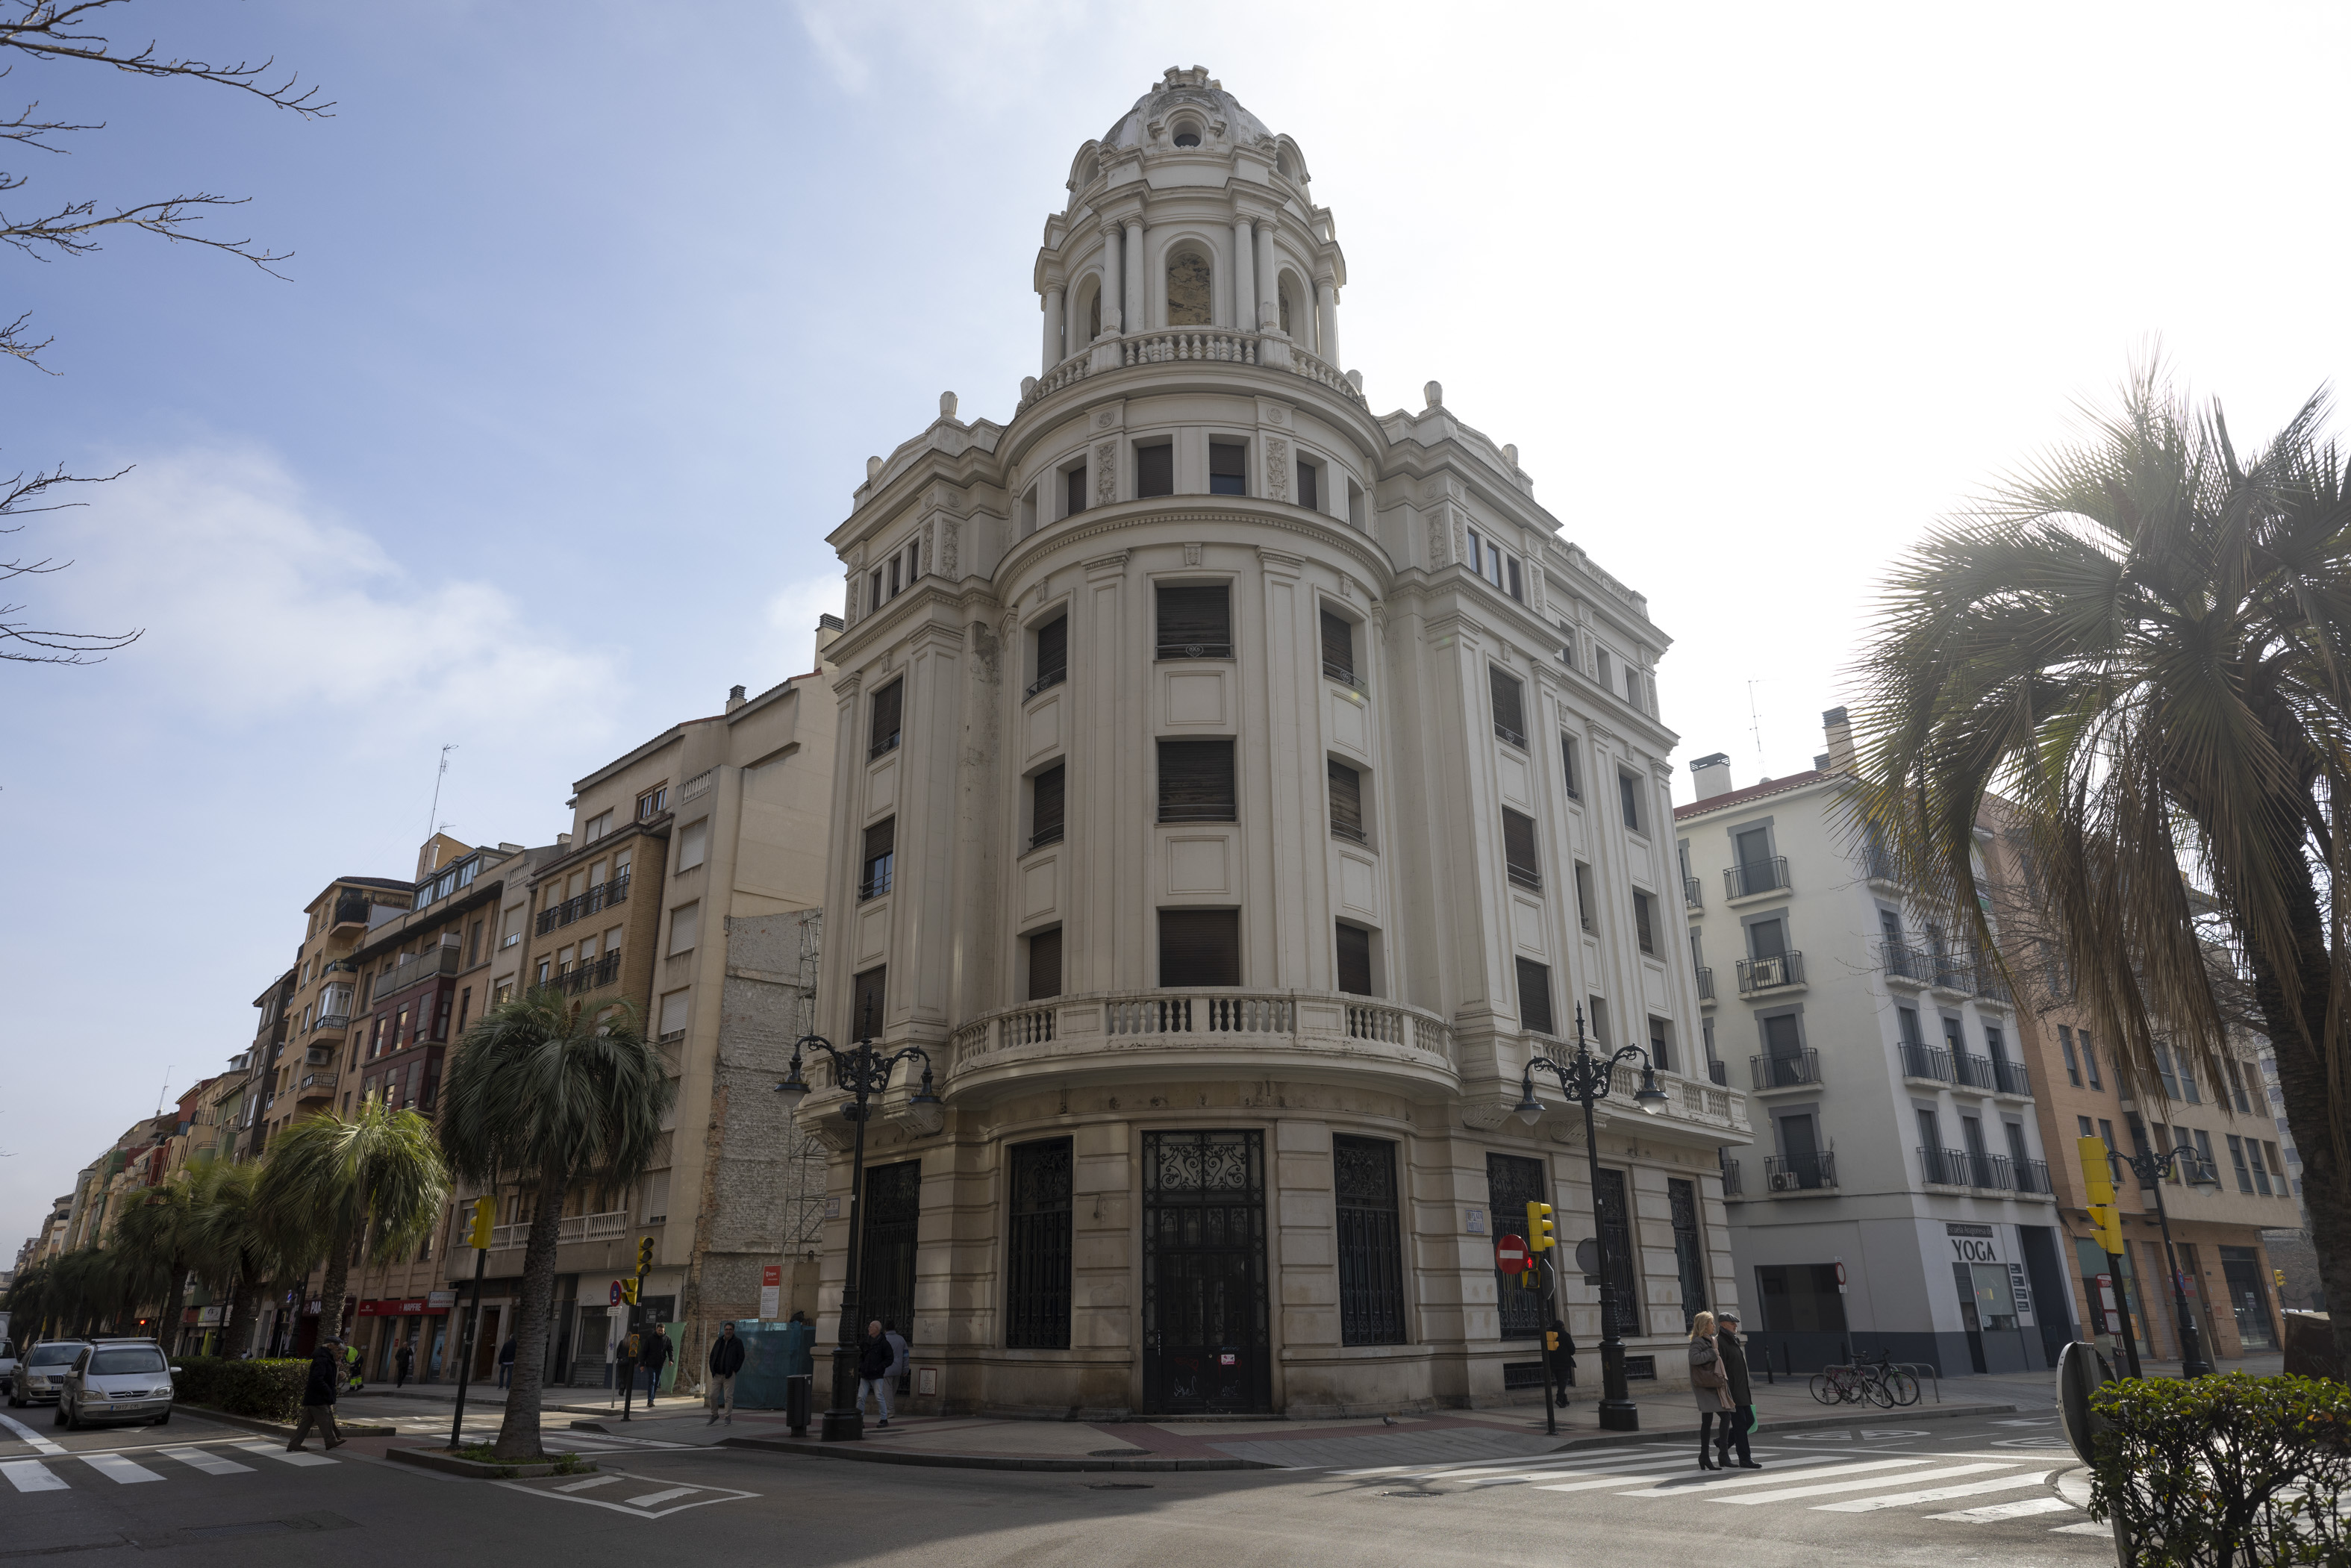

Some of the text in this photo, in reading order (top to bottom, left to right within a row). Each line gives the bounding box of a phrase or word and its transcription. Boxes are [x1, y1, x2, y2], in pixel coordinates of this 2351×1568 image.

[1468, 1222, 1482, 1230] PORTILLO
[1946, 1225, 1993, 1236] Escuela Aragonesa de
[1952, 1239, 1996, 1261] YOGA
[403, 1303, 422, 1311] MAPFRE
